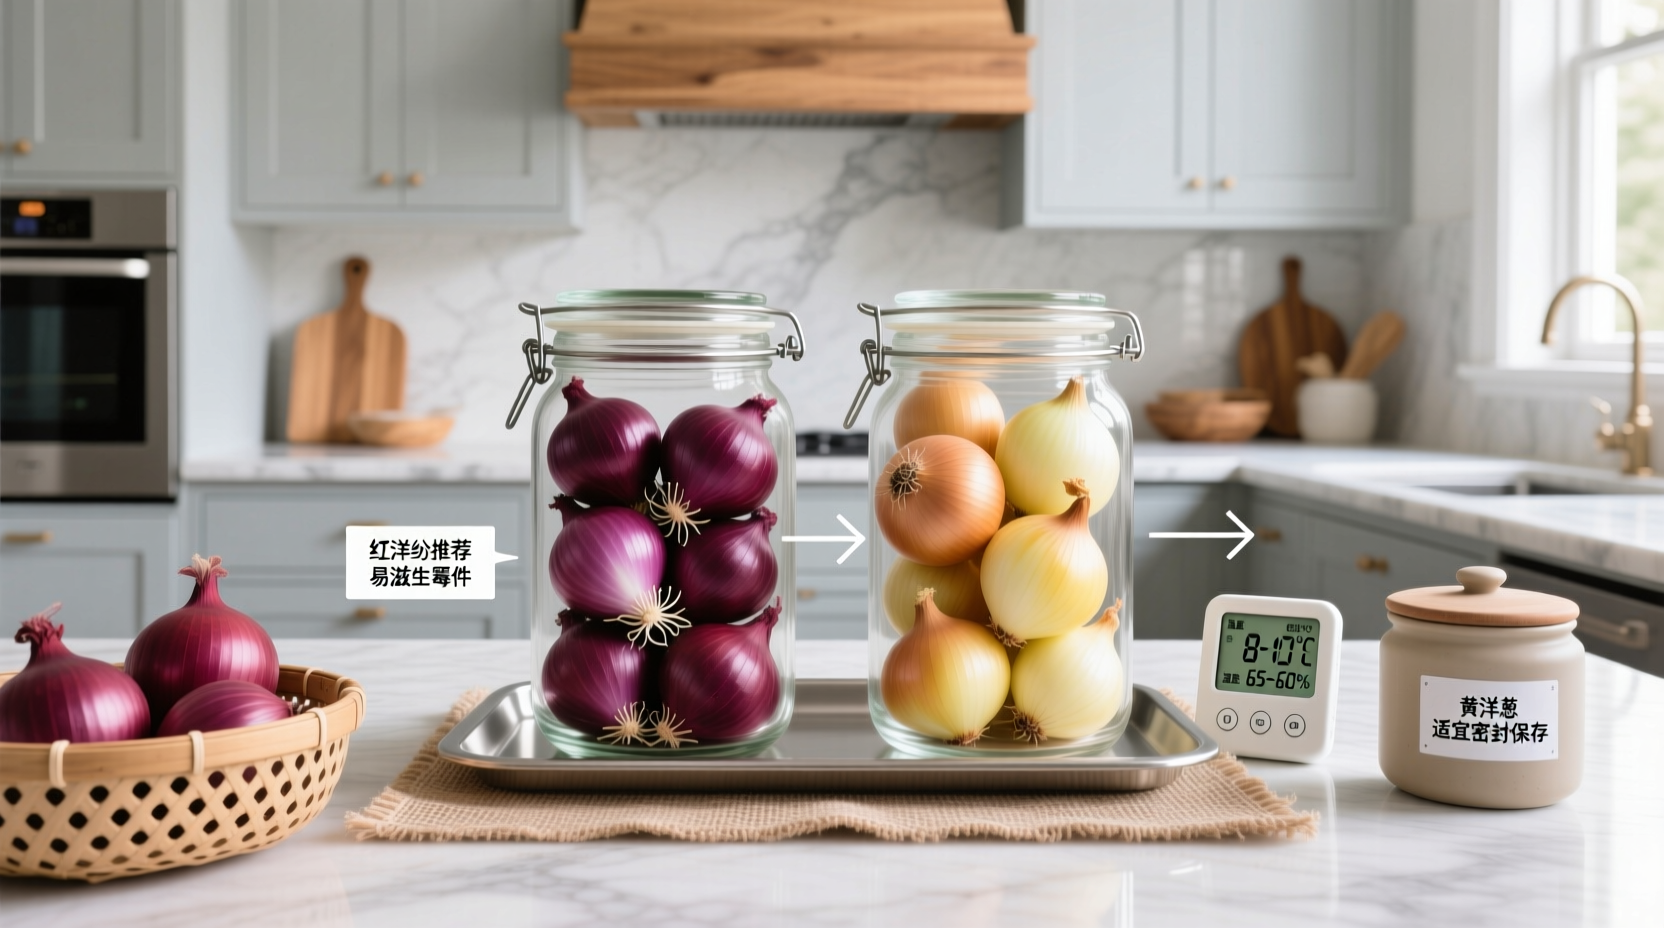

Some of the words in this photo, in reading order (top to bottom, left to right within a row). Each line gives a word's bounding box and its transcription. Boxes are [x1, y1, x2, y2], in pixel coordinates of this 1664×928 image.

[1246, 669, 1310, 689] 65-60%
[1460, 695, 1518, 719] 黄洋葱
[1432, 718, 1548, 743] 适宜密封保存
